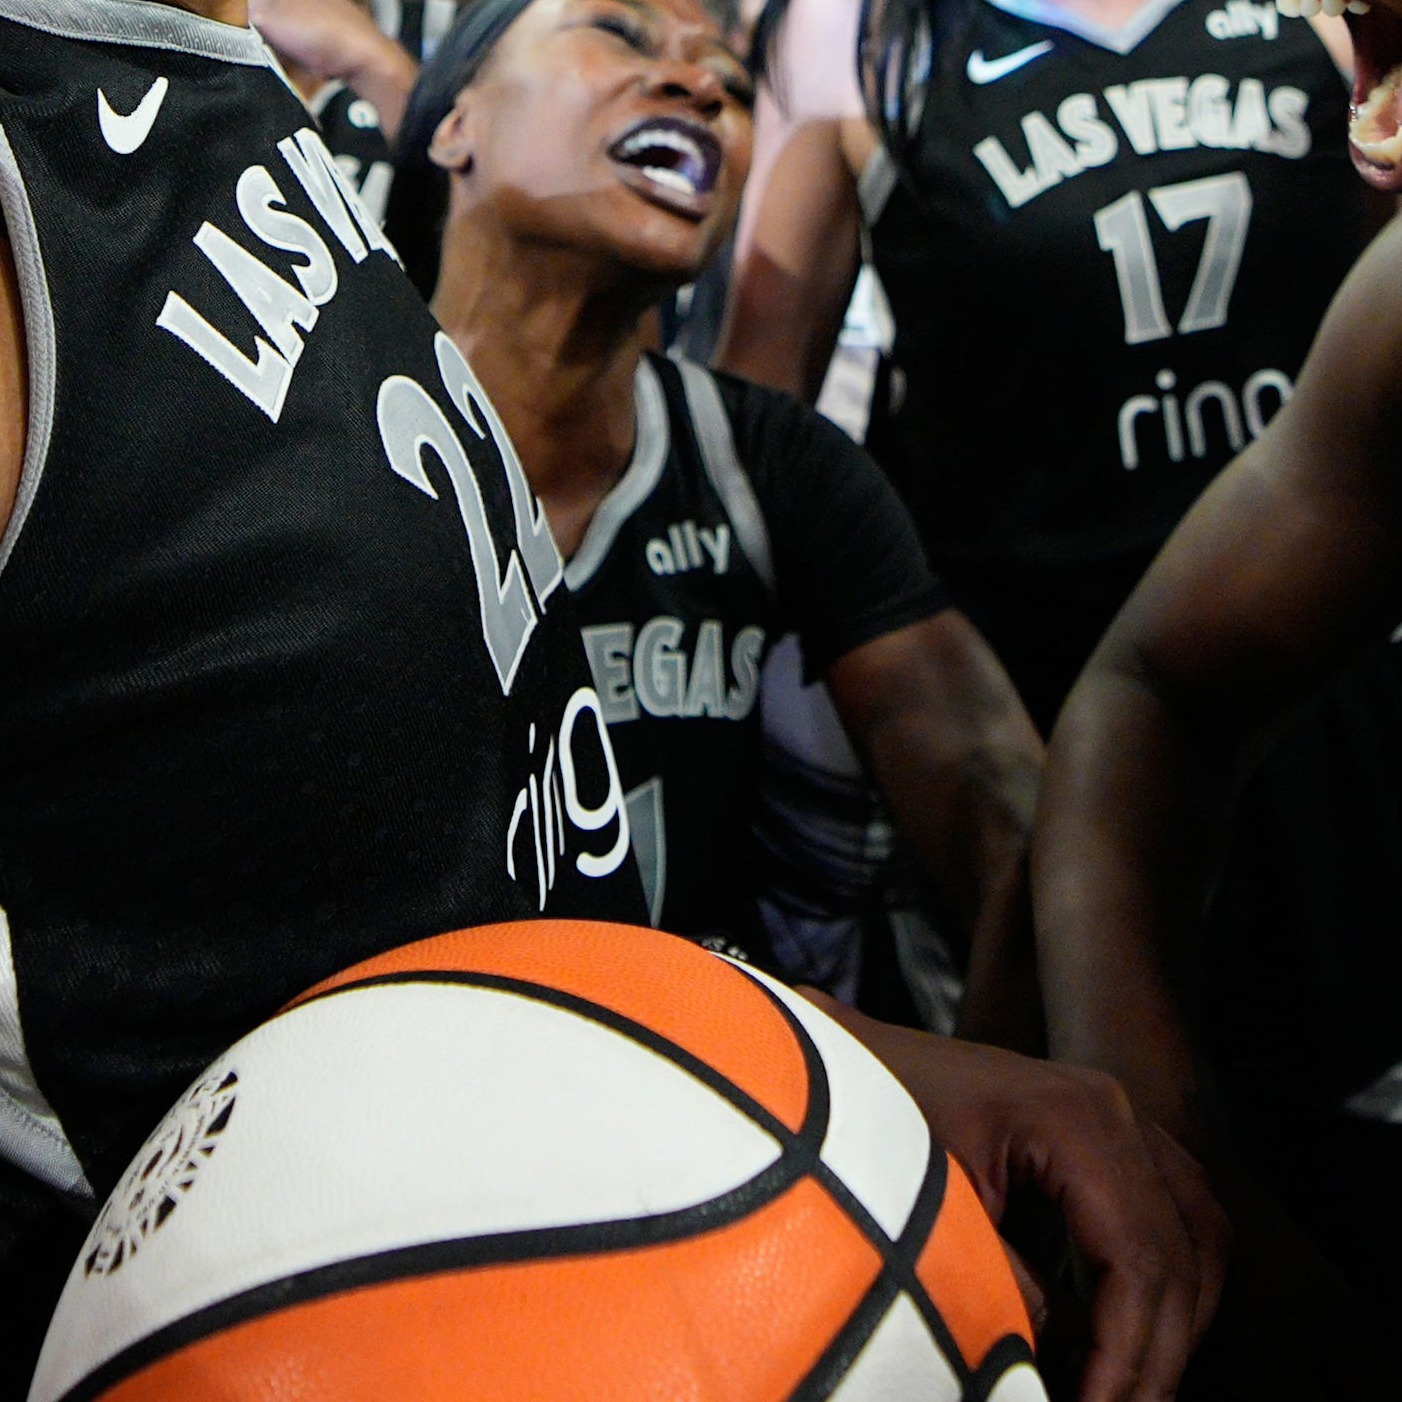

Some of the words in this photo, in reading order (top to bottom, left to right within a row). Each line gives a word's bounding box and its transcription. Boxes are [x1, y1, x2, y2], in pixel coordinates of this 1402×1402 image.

[972, 93, 1119, 208] LAS
[1103, 73, 1312, 159] VEGAS
[156, 164, 339, 424] LAS
[1093, 171, 1253, 346] 17
[376, 330, 565, 696] 22
[645, 519, 730, 576] ally
[580, 615, 766, 725] EGAS
[507, 686, 631, 912] ring
